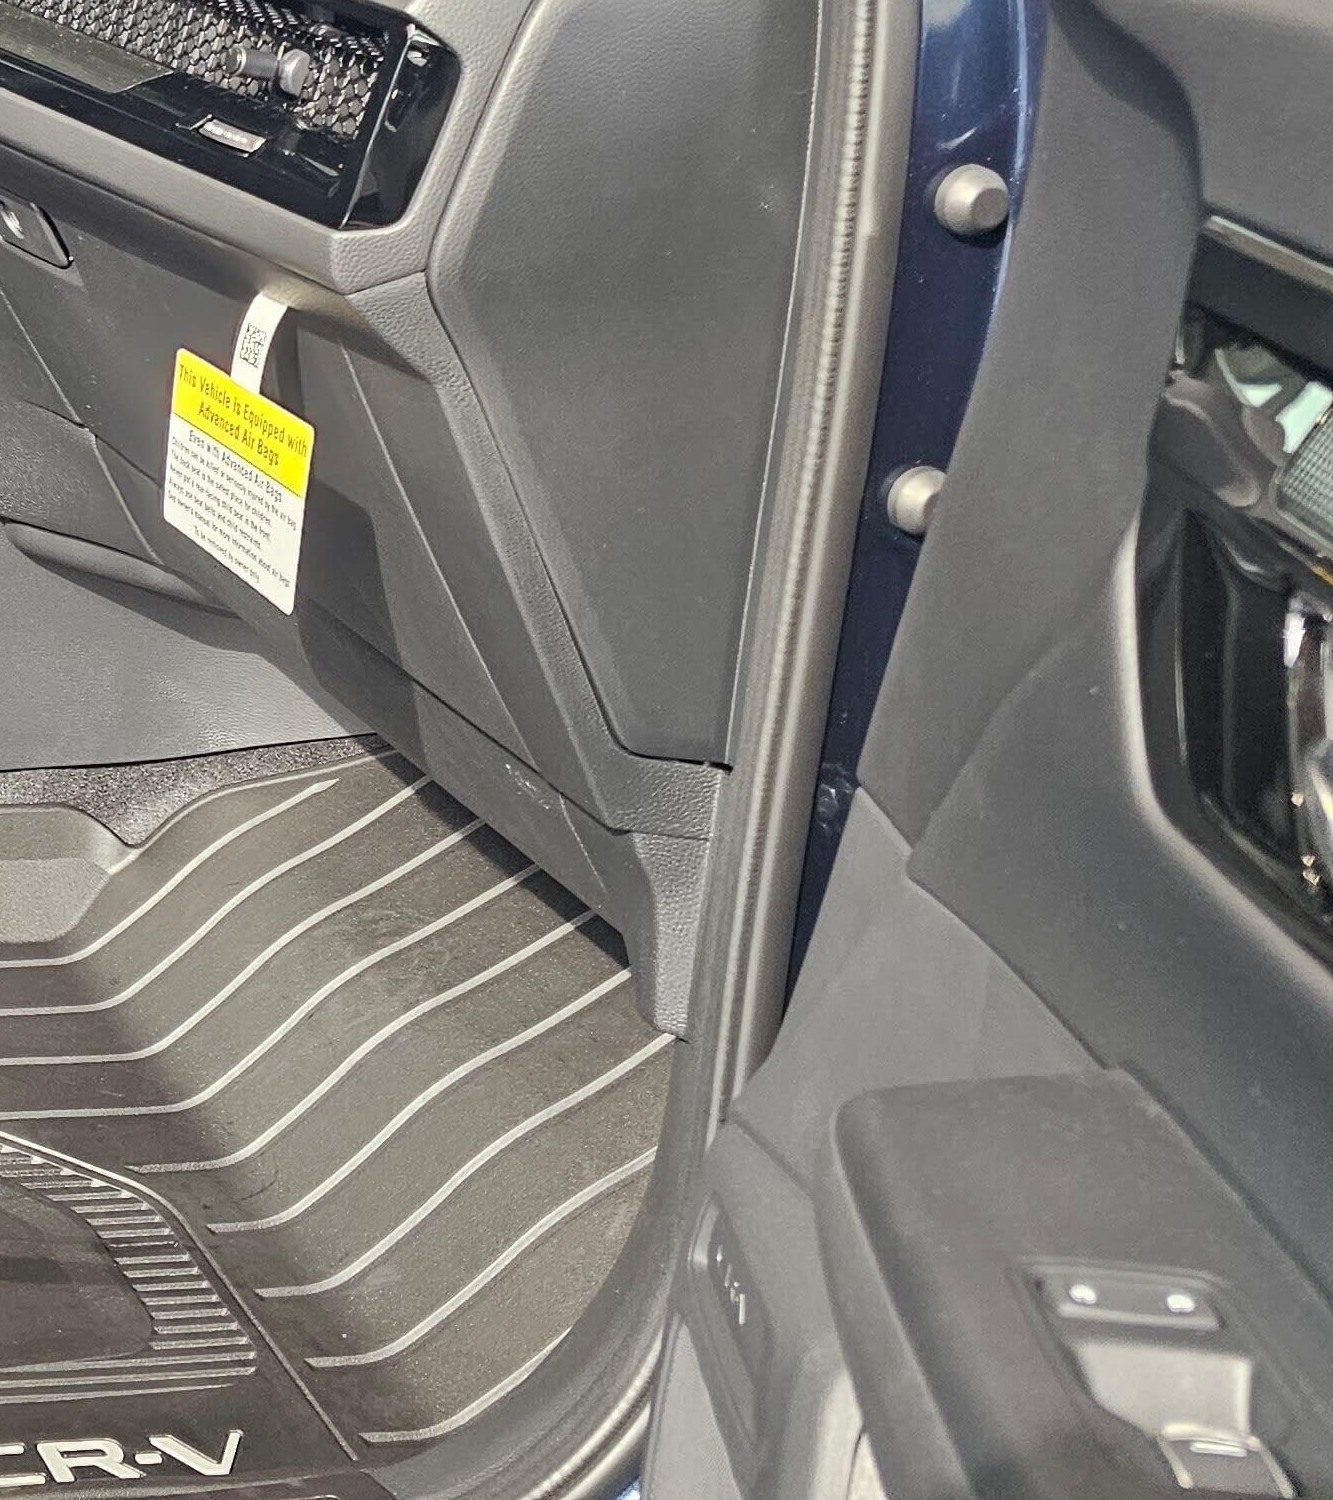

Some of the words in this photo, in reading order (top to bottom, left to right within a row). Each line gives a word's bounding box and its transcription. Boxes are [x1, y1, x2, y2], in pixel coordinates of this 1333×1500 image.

[179, 364, 196, 388] This
[200, 376, 231, 409] Vehicle
[243, 404, 285, 443] Equipped
[287, 434, 308, 458] with
[198, 401, 240, 440] Advanced
[242, 427, 255, 450] Air
[257, 438, 279, 466] Bags
